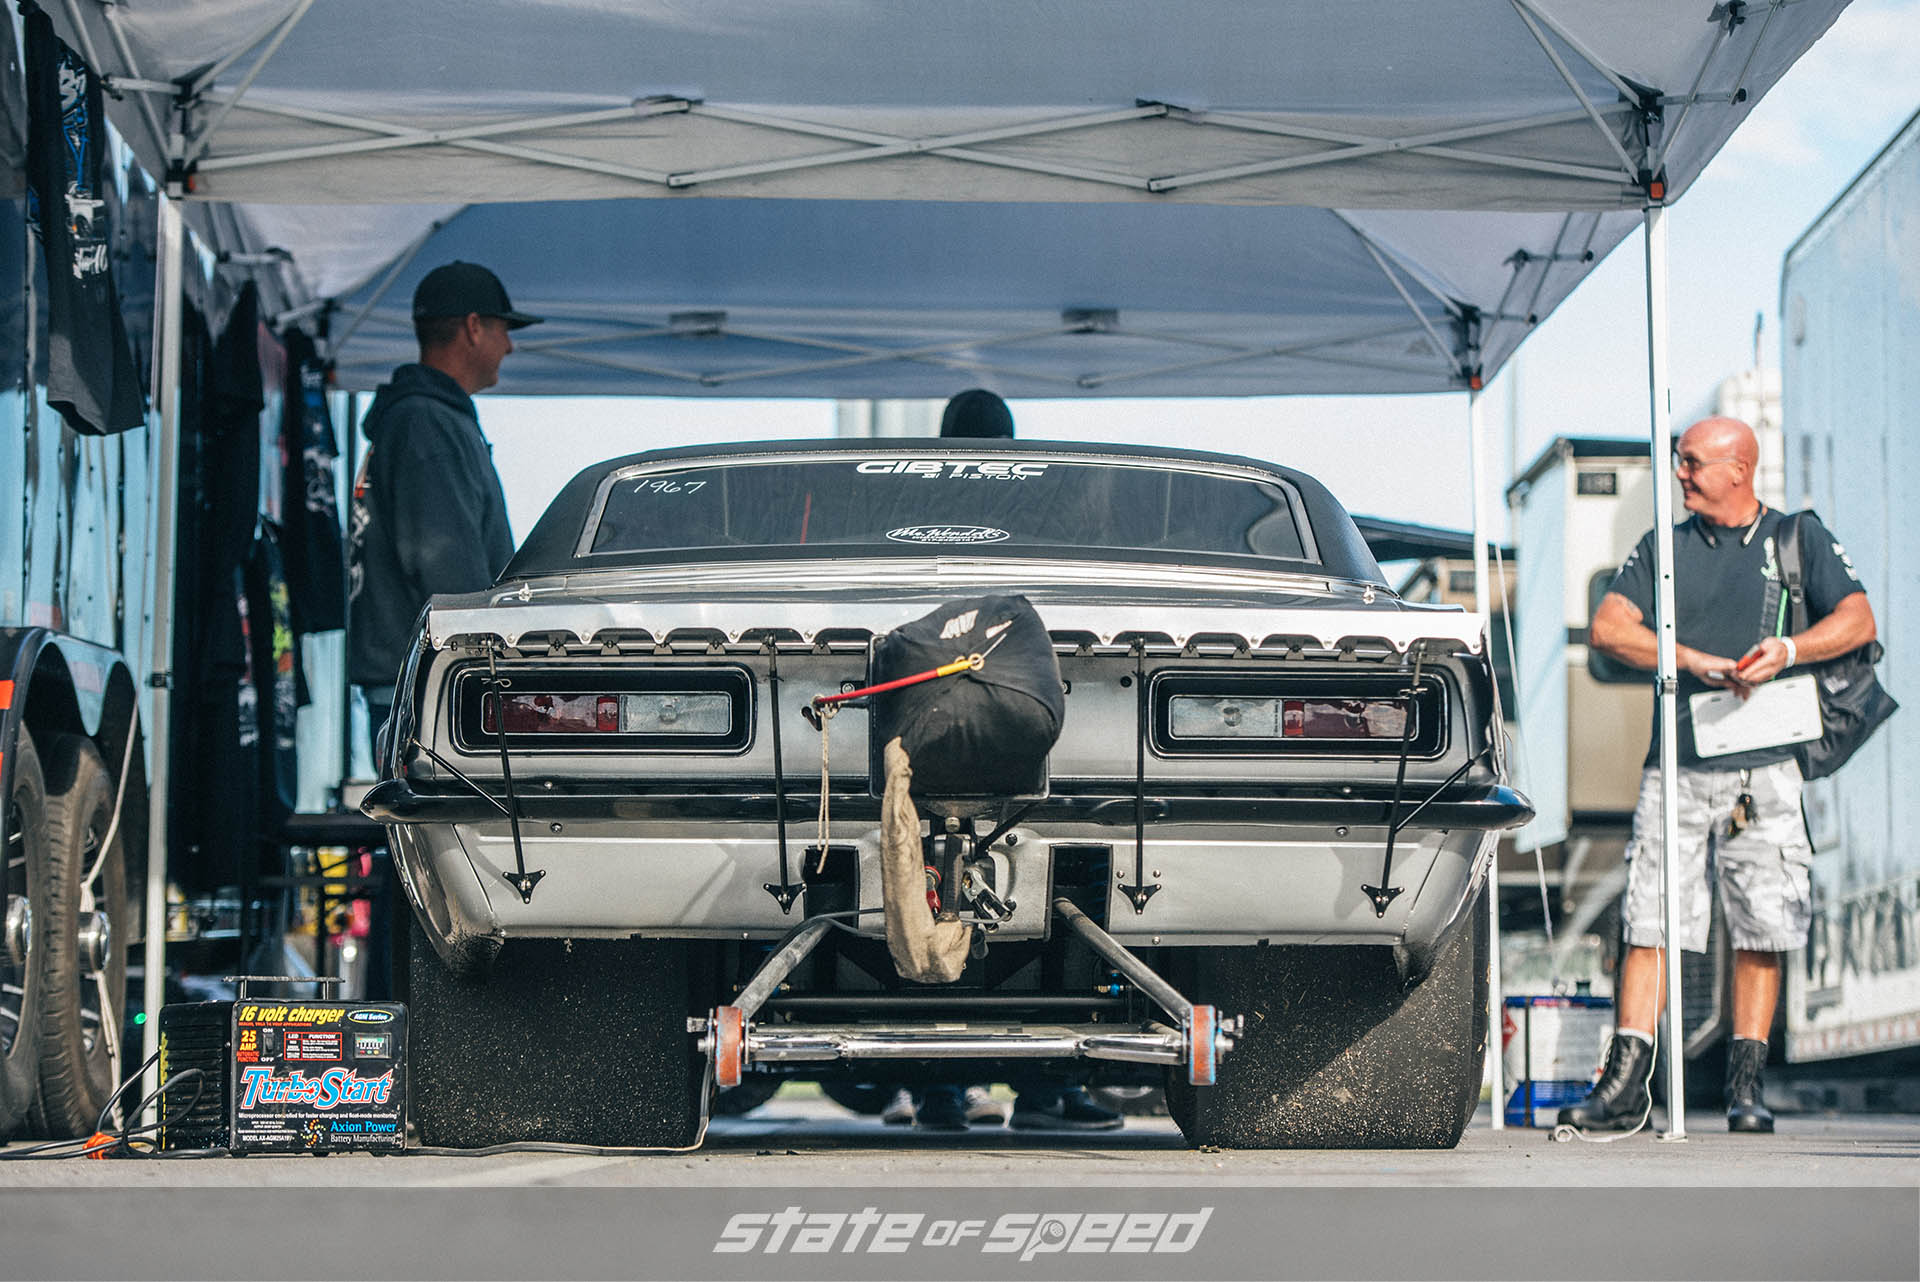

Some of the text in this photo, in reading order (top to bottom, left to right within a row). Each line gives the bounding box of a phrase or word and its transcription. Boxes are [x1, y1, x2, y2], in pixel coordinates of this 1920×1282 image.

[856, 461, 1048, 476] GIBTEC
[949, 473, 1028, 481] PISTON
[633, 479, 707, 494] 1967
[239, 1006, 345, 1025] 16 volt charger
[241, 1030, 257, 1043] 25
[239, 1043, 257, 1051] AMP
[240, 1066, 394, 1110] TurboStart
[330, 1121, 396, 1132] Axion Power
[330, 1134, 395, 1144] Battery Manufacturing
